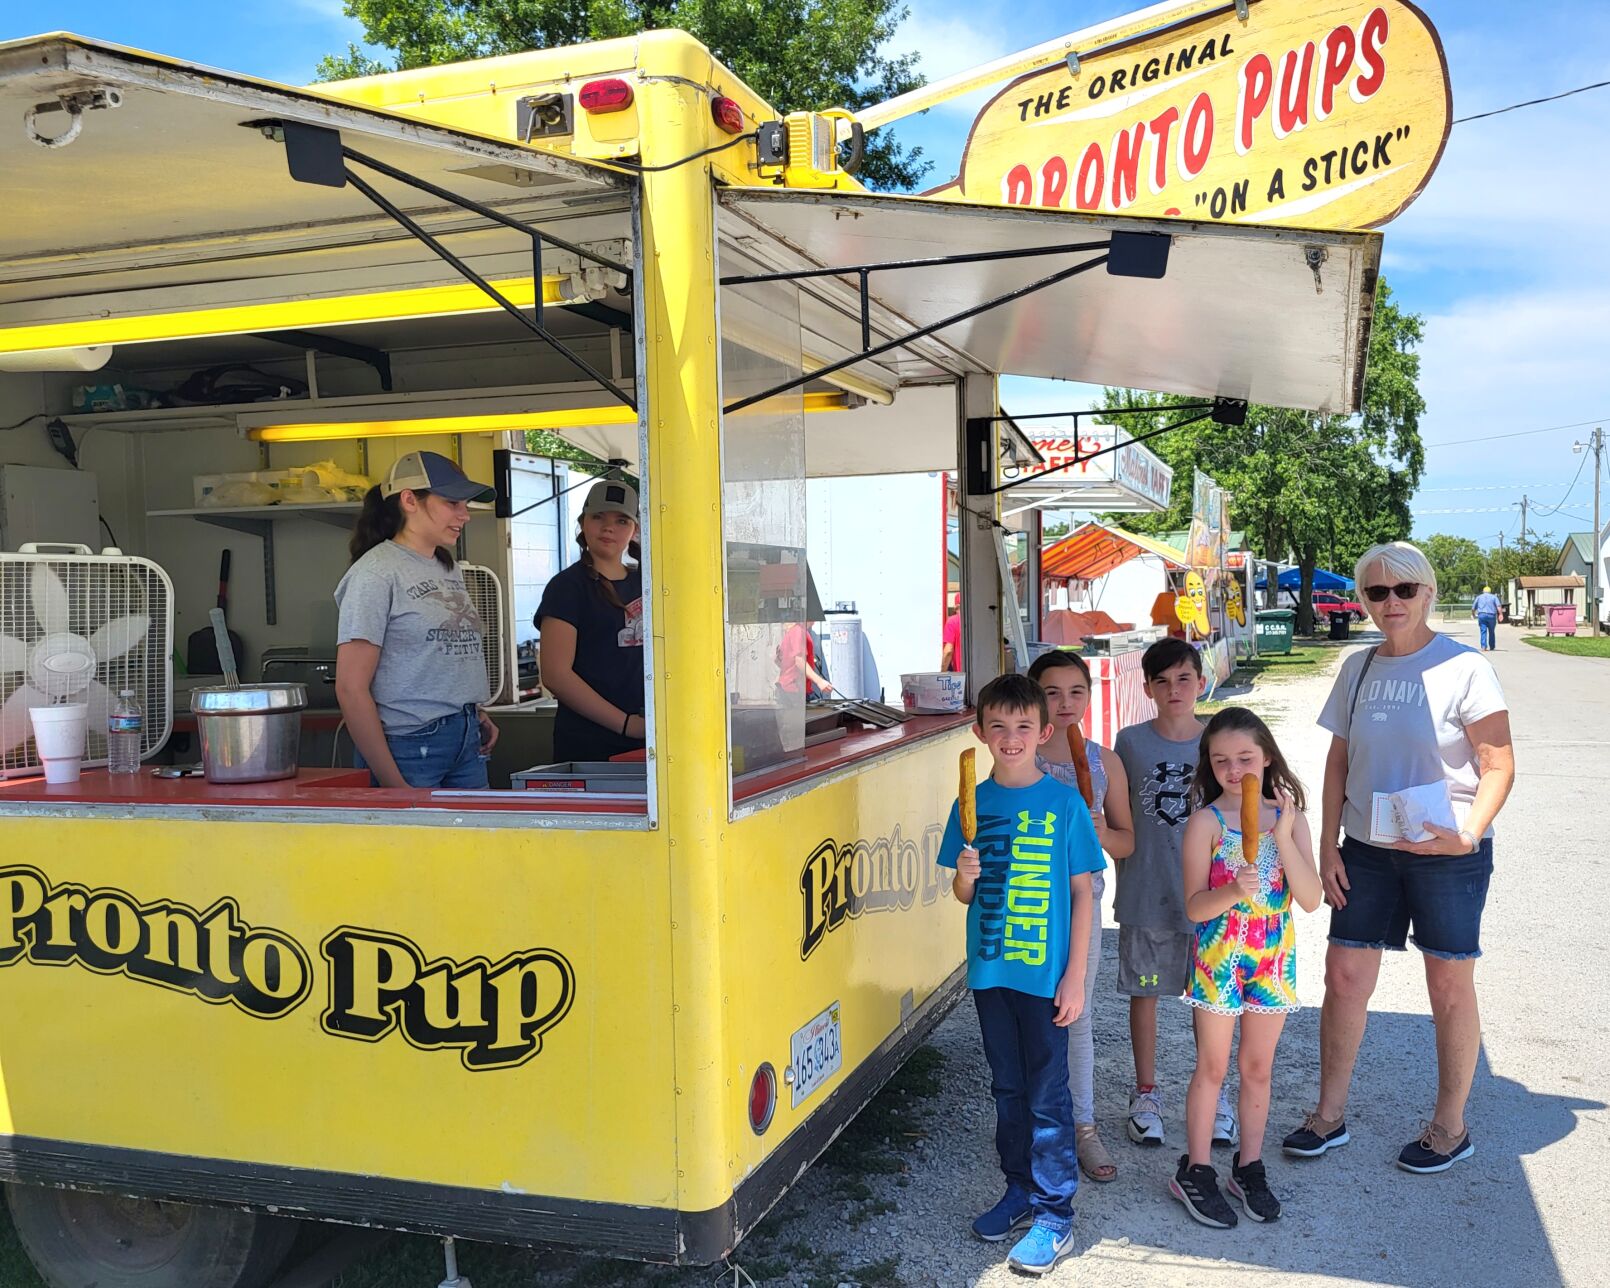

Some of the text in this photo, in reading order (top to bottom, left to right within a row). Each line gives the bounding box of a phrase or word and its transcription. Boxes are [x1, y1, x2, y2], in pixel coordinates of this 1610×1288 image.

[1018, 32, 1236, 121] THE ORIGINAL
[1237, 6, 1389, 153] PUPS
[1267, 168, 1285, 202] A
[407, 579, 439, 600] STARS
[1383, 680, 1429, 707] NAVY
[549, 780, 572, 788] DANGER
[802, 826, 919, 958] Pronto
[975, 814, 1012, 962] ARMOUR
[1004, 836, 1053, 966] UNDER
[0, 867, 573, 1069] Pronto Pup
[796, 1044, 813, 1092] 165
[819, 1028, 835, 1070] 343
